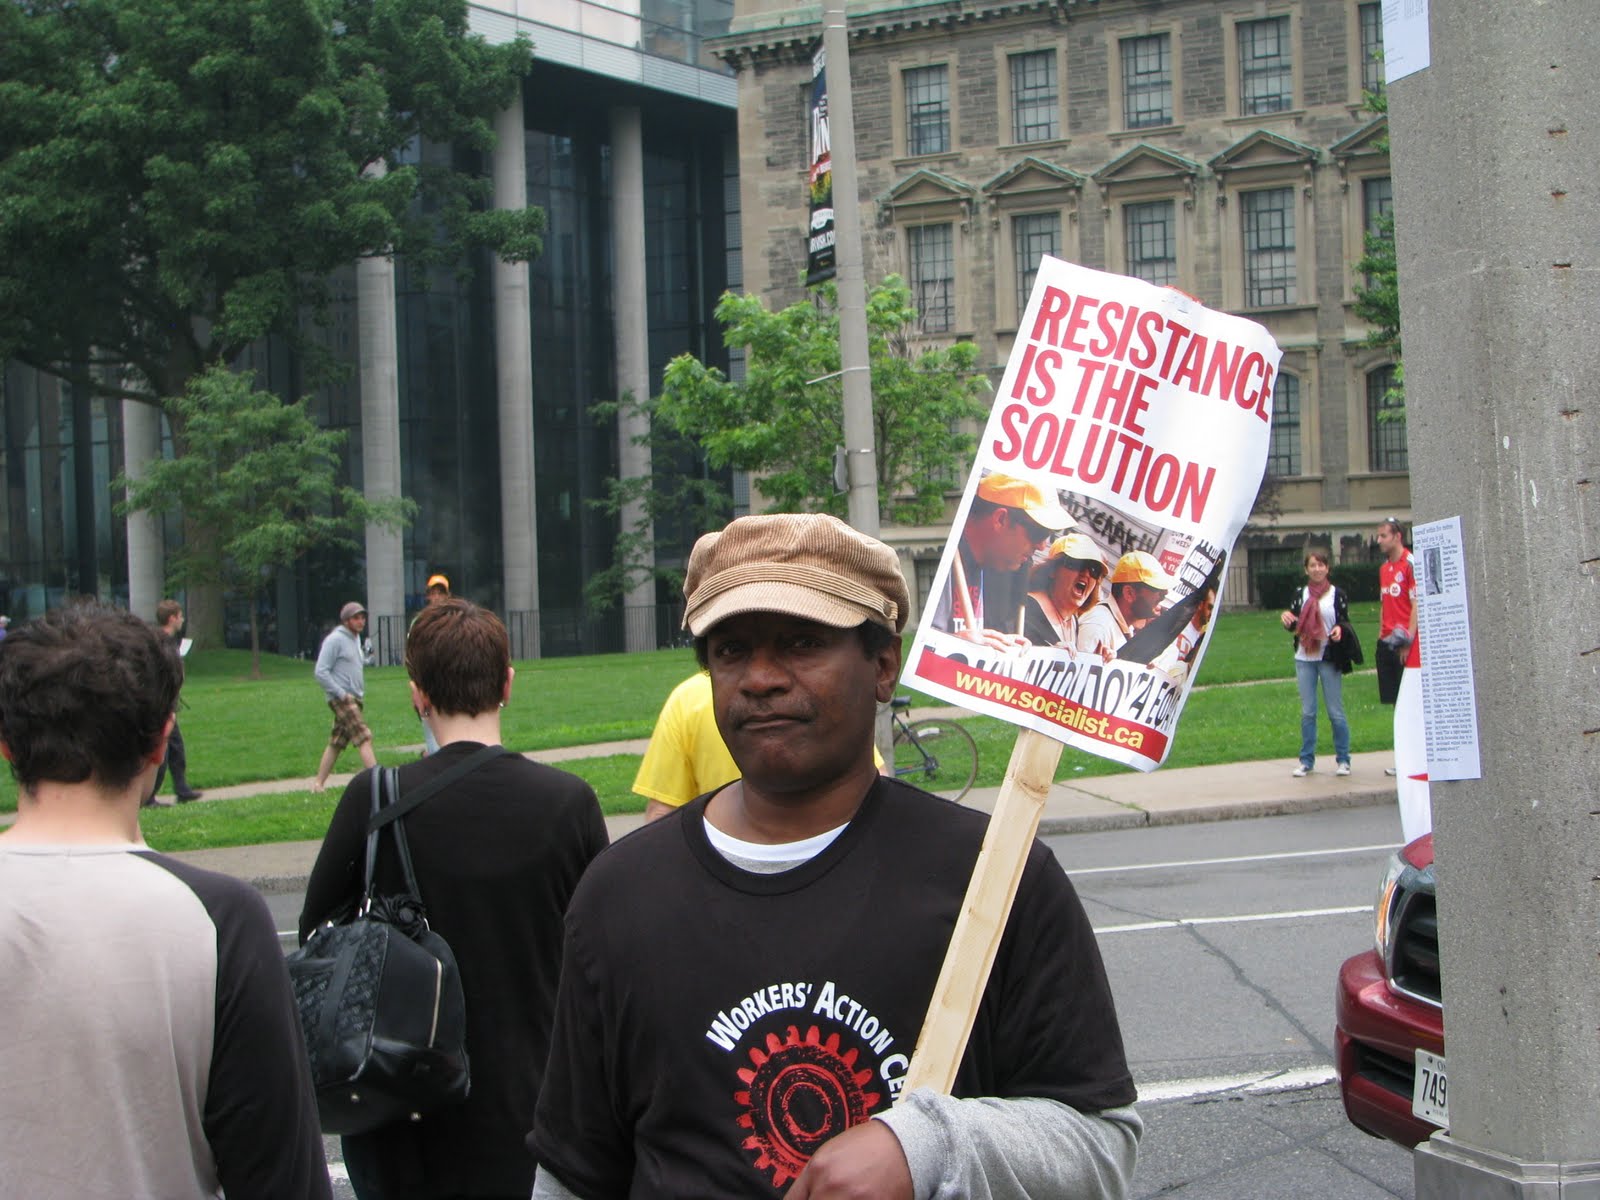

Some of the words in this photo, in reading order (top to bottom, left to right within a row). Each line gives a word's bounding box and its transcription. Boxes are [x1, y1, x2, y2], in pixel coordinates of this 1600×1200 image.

[1011, 344, 1063, 406] IS
[1071, 358, 1159, 436] THE
[1030, 285, 1274, 423] RESISTANCE
[992, 403, 1217, 524] SOLUTION
[955, 670, 1144, 749] www.socialist.ca
[813, 981, 894, 1055] ACTION
[1422, 1068, 1447, 1108] 749
